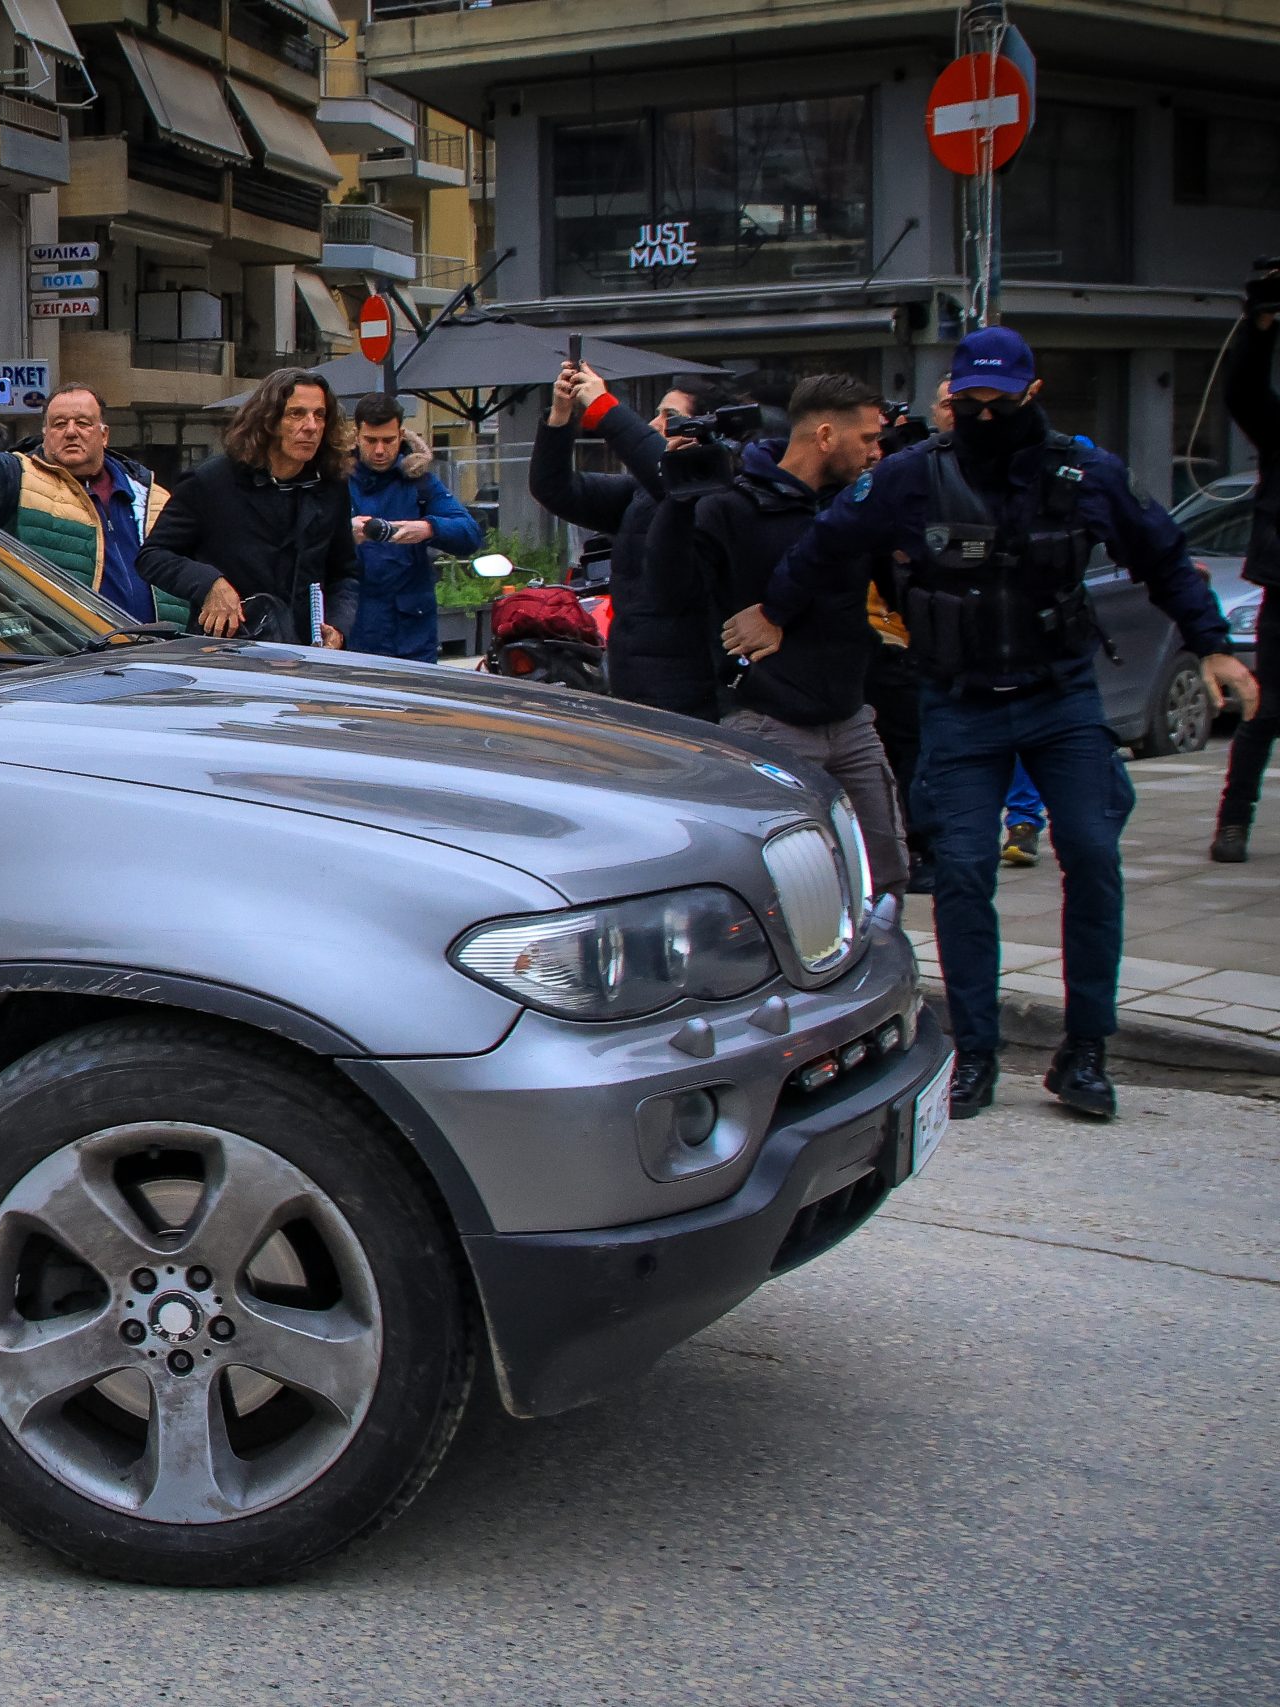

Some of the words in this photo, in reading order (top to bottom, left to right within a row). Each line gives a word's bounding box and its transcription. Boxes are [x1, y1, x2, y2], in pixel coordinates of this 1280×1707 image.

[635, 222, 690, 248] JUST
[33, 246, 91, 260] ΨΙΛΙΚΑ
[629, 242, 697, 268] MADE
[41, 274, 84, 288] ΠΟΤΑ
[33, 301, 91, 315] ΤΣΙΓΑΡΑ
